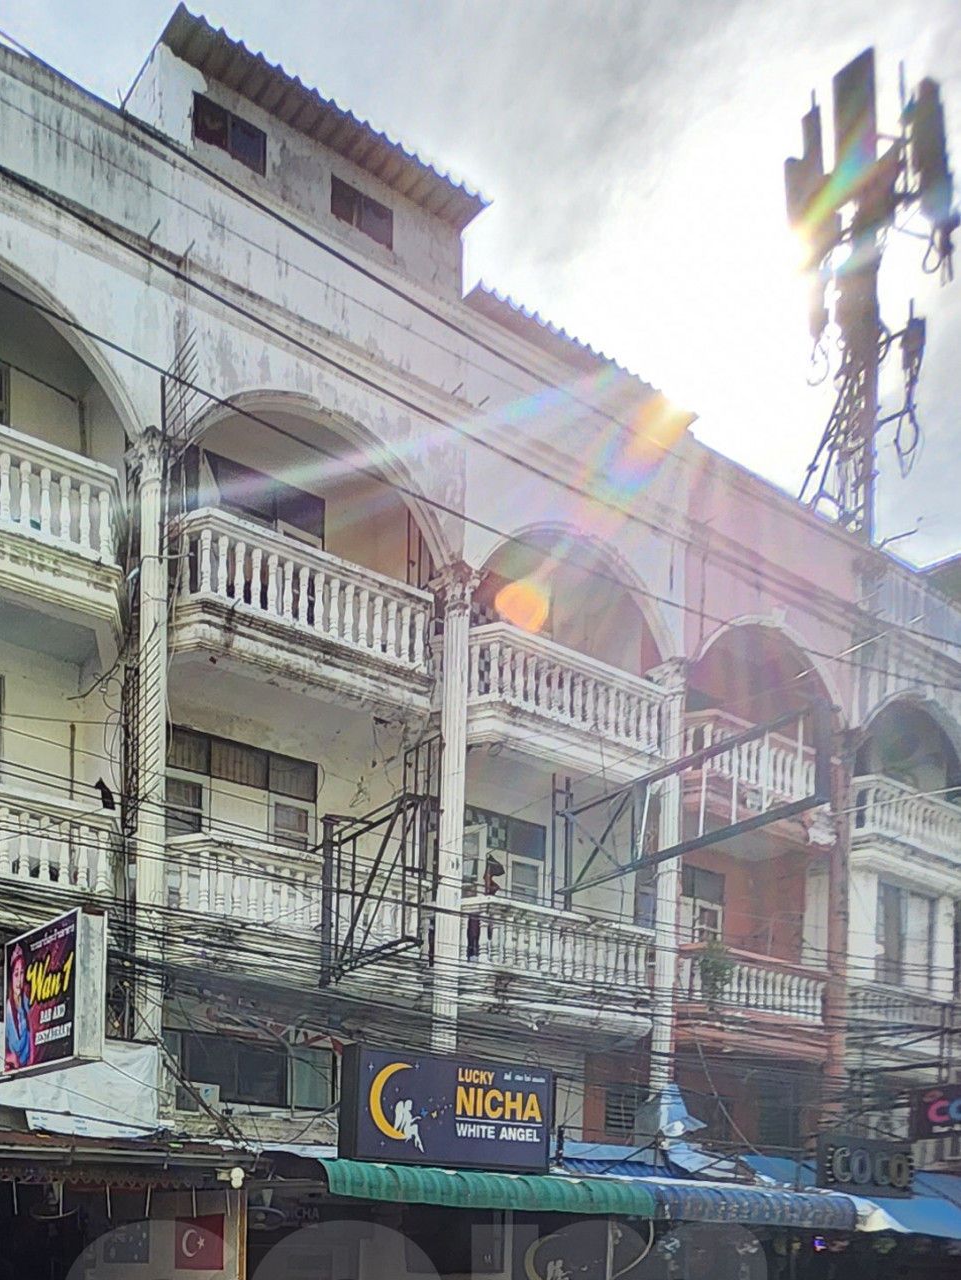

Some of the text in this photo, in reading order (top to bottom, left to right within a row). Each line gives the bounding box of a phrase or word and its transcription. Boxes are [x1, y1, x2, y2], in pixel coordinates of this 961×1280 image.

[458, 1067, 495, 1085] LUCKY
[456, 1086, 542, 1122] NICHA
[456, 1123, 540, 1142] WHITE ANGEL
[832, 1147, 910, 1188] COCO
